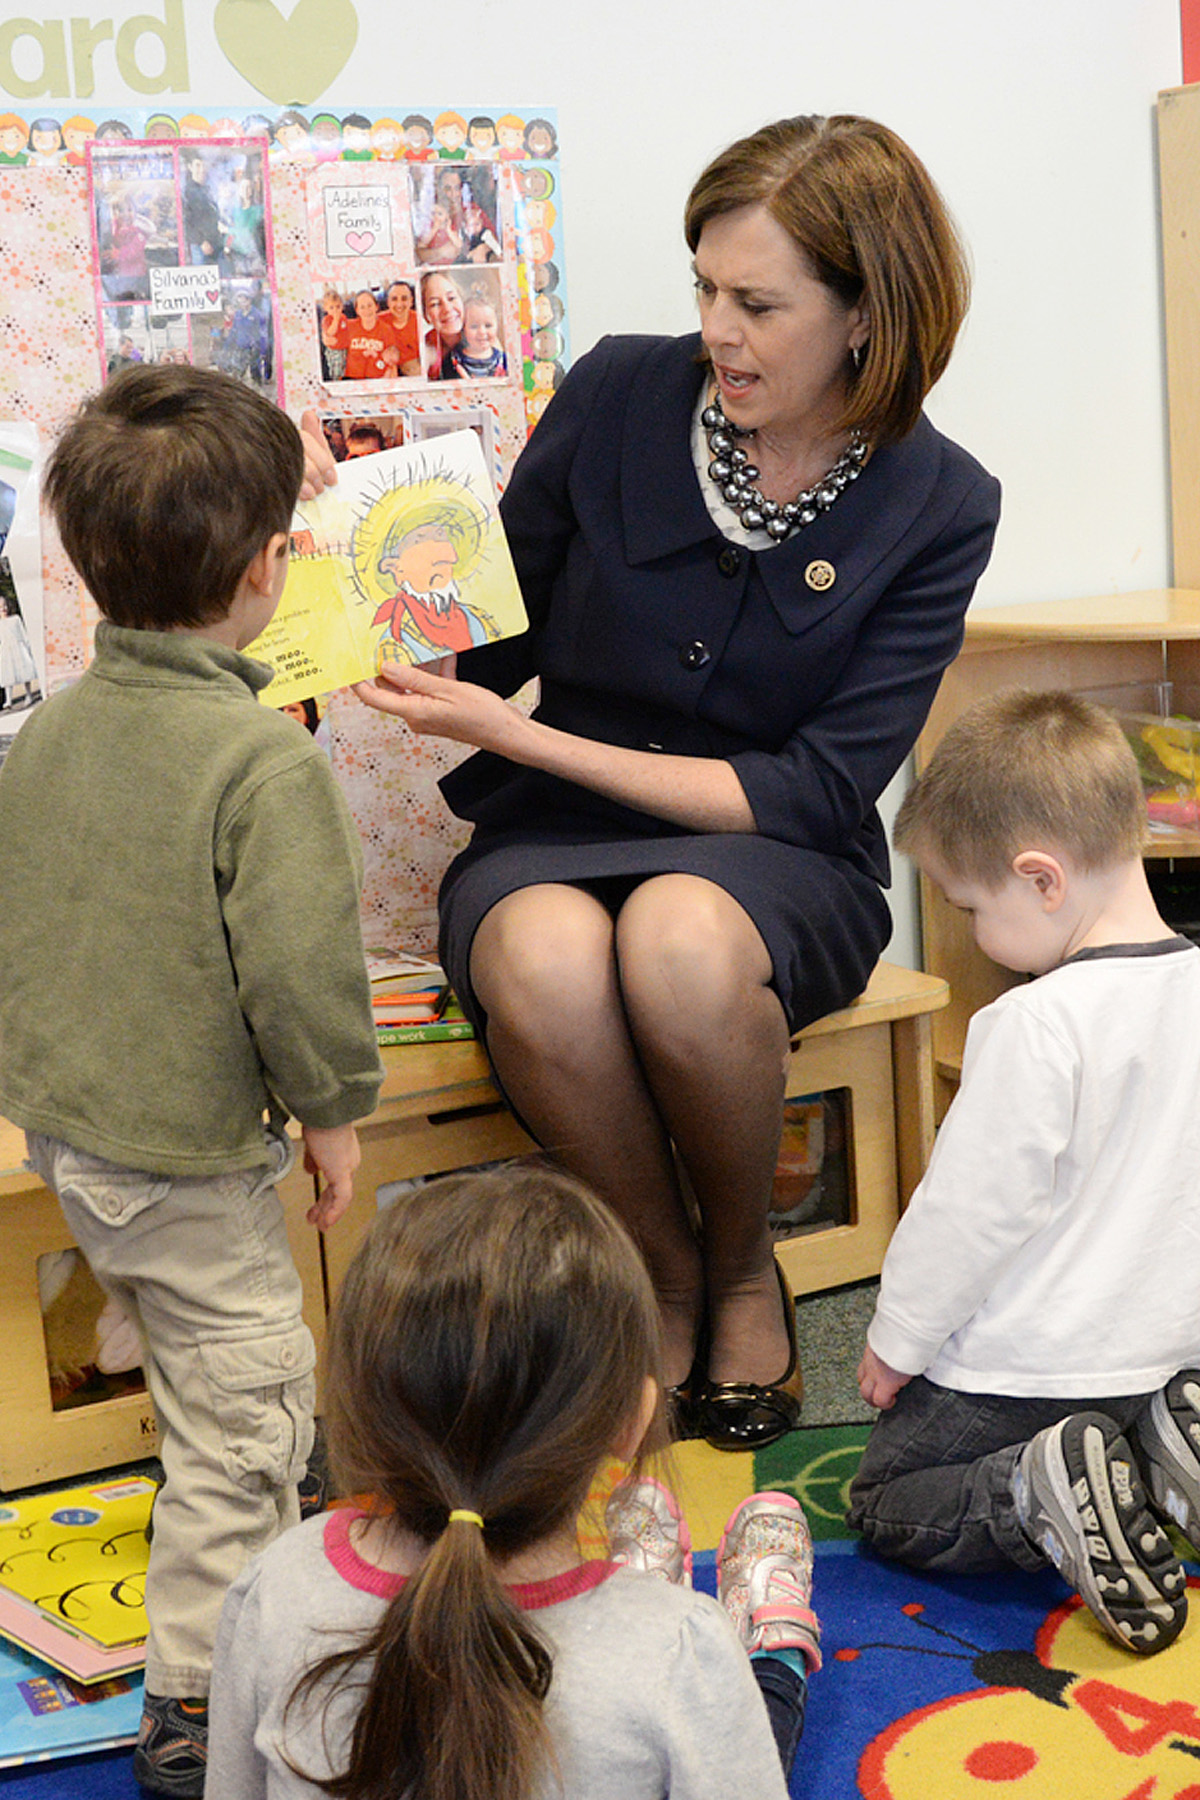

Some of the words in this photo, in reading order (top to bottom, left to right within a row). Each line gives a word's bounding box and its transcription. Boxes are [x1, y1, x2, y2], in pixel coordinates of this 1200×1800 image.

[337, 211, 382, 232] Family
[153, 268, 217, 288] Silvana's
[154, 290, 205, 310] Family
[399, 1030, 425, 1042] work
